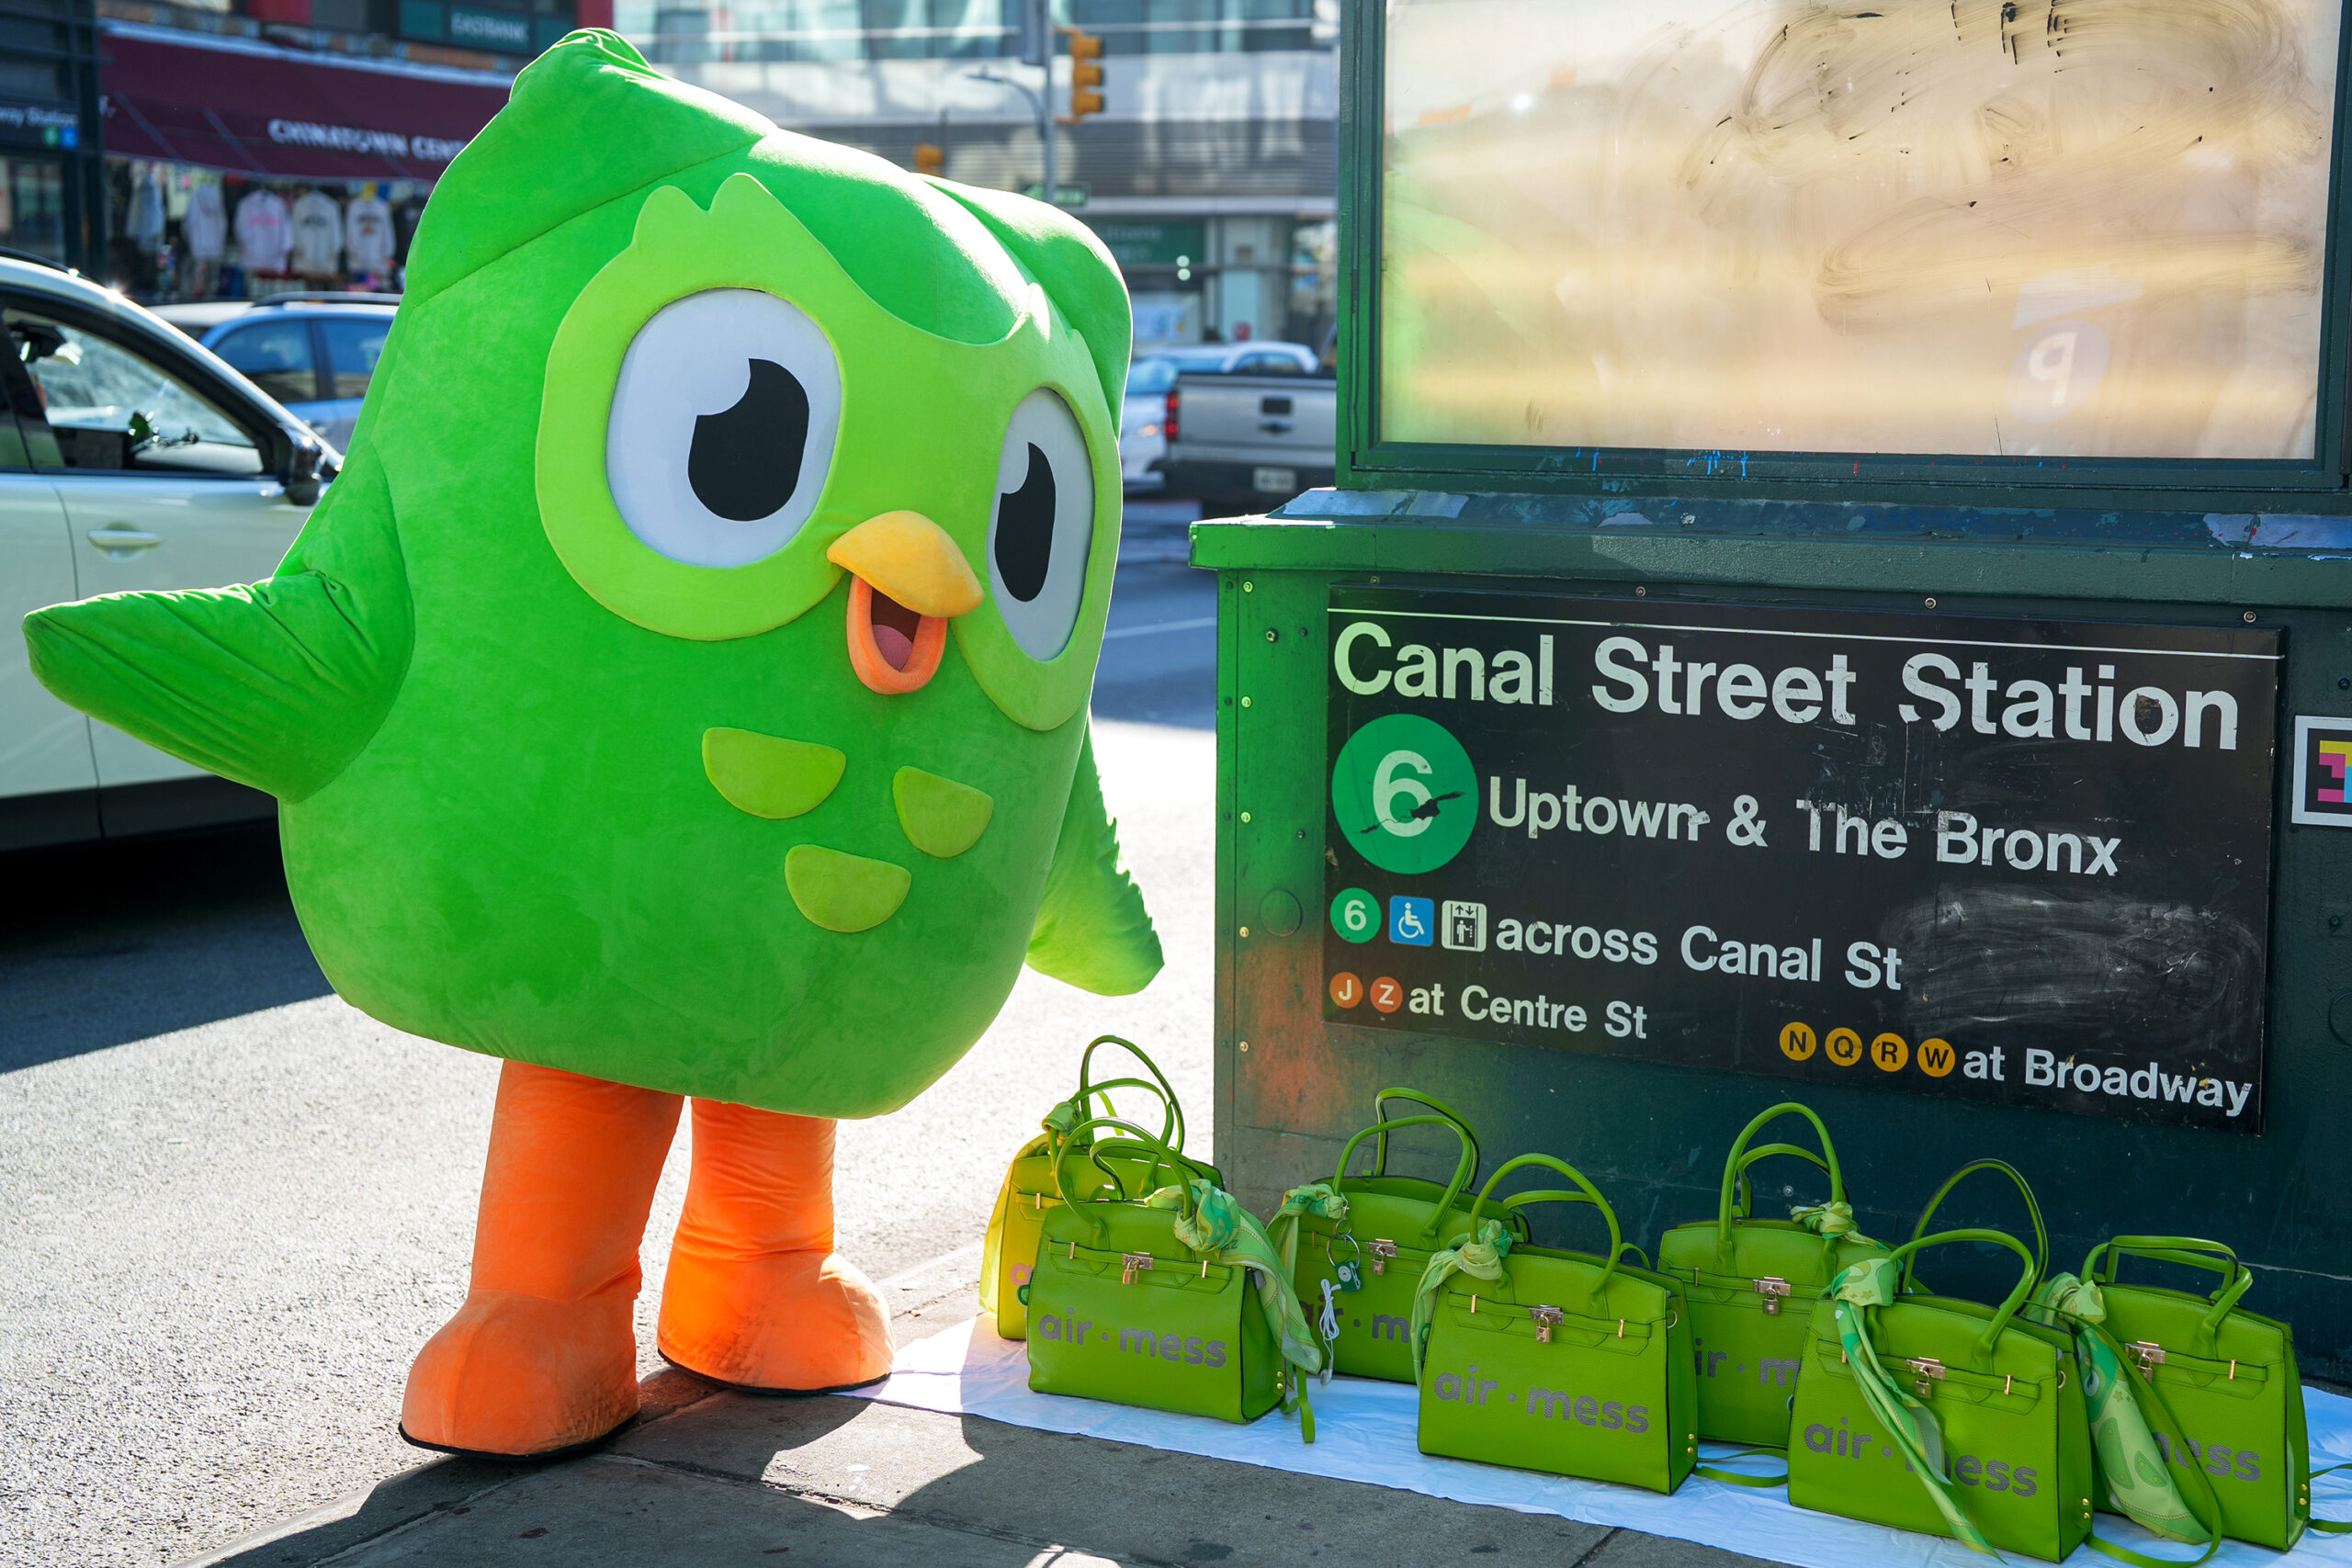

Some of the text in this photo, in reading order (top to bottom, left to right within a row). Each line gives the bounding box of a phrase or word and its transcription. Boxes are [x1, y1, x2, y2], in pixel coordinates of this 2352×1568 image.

[1334, 621, 2239, 750] Canal Street Station
[1373, 750, 2122, 877] 6 Uptown & The Bronx
[1344, 900, 1903, 990] 6 across Canal St
[1338, 979, 1647, 1040] J Z at Centre St
[1789, 1030, 2253, 1117] N Q R W at Broadway
[1038, 1307, 1227, 1369] air mess
[1694, 1337, 1728, 1378] ir
[1434, 1364, 1650, 1434] air mess
[1804, 1416, 1873, 1460] air
